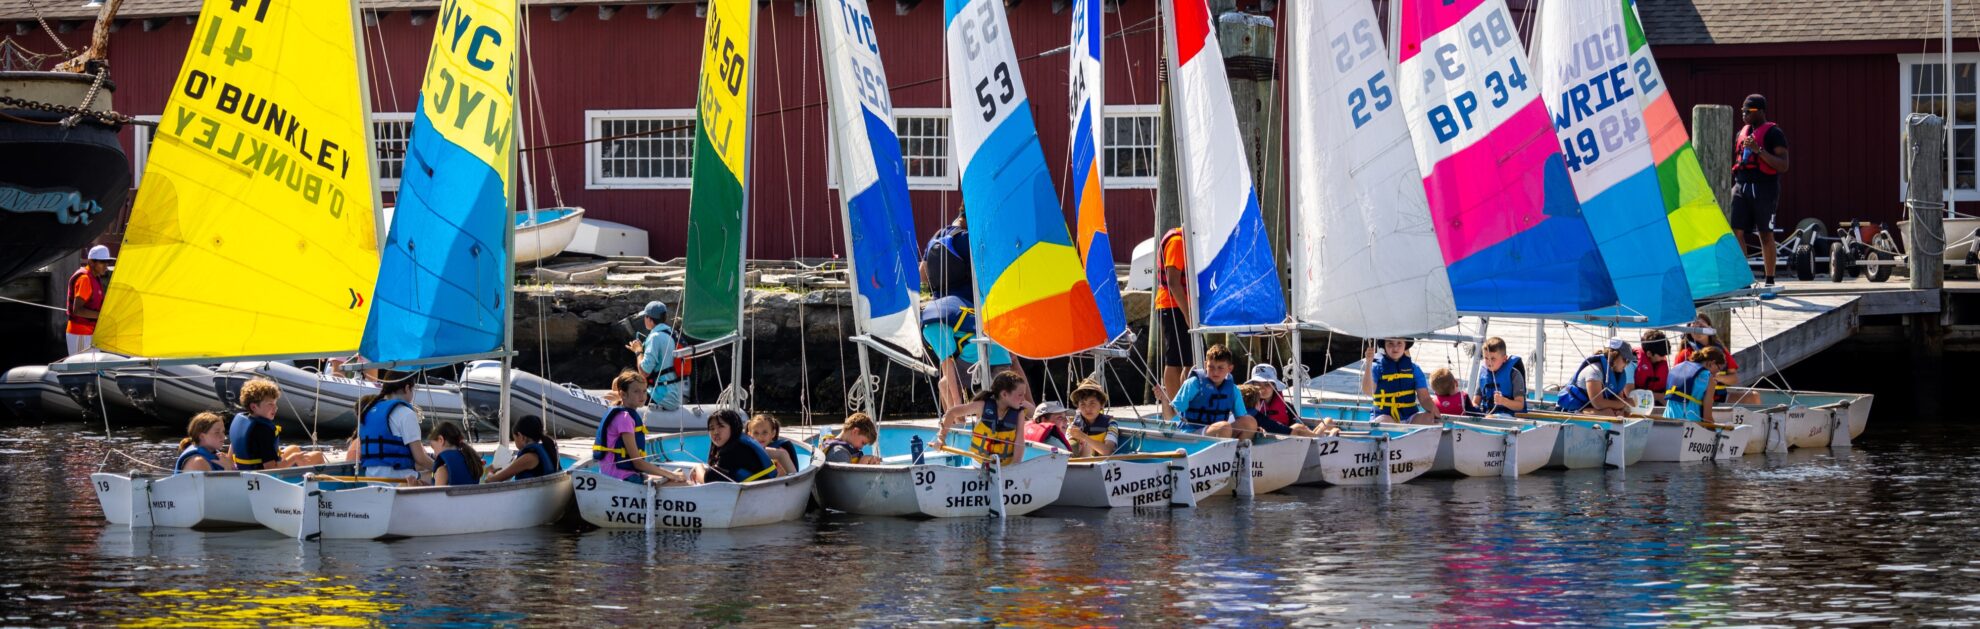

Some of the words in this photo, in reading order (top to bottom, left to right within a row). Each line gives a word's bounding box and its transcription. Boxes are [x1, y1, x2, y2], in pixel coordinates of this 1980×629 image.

[719, 36, 745, 97] 50
[975, 61, 1015, 122] 53
[1347, 69, 1393, 129] 25
[1427, 104, 1478, 144] BP
[1484, 56, 1528, 109] 34
[184, 69, 350, 180] O'BUNKLEY
[1563, 127, 1600, 173] 49
[1734, 415, 1744, 424] 35
[1684, 427, 1694, 438] 21
[1320, 440, 1339, 456] 22
[915, 471, 936, 486] 30
[1104, 467, 1122, 483] 45
[1111, 473, 1172, 497] ANDERSO
[1189, 461, 1231, 480] SLAND
[98, 482, 110, 492] 19
[247, 480, 260, 491] 51
[575, 477, 597, 491] 29
[961, 480, 989, 494] JOH
[1004, 480, 1018, 490] P.
[606, 511, 658, 525] YACH
[662, 515, 703, 528] CLUB
